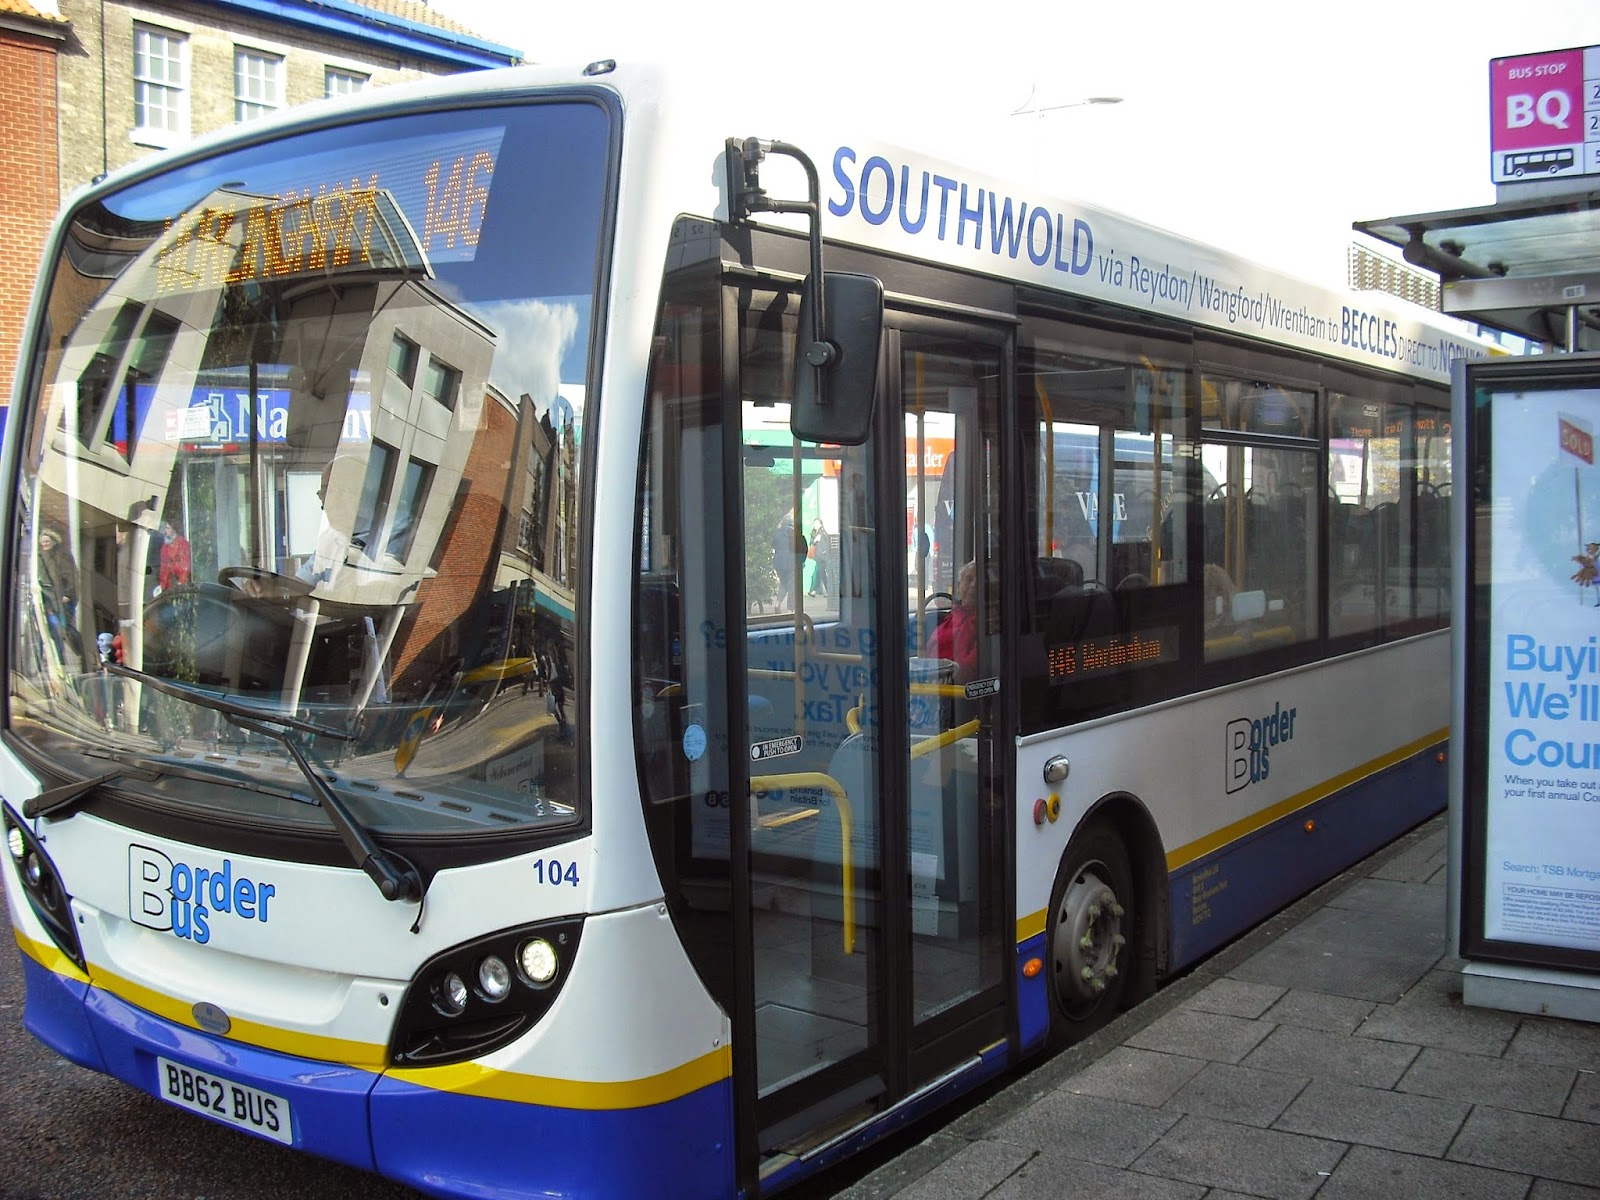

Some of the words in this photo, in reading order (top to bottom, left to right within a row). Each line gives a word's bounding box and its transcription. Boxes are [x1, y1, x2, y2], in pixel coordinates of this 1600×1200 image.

[1508, 67, 1533, 80] BUS
[1535, 63, 1567, 77] STOP
[1507, 90, 1571, 130] BQ
[422, 151, 494, 251] 146
[827, 145, 1095, 276] SOUTHWOLD
[1099, 249, 1124, 287] via
[1329, 318, 1339, 343] to
[1341, 305, 1398, 359] BECCLES
[1399, 336, 1427, 367] DIRECT
[1427, 345, 1438, 371] TO
[1562, 429, 1592, 457] SOLD
[1075, 491, 1128, 522] VAE
[1048, 645, 1077, 677] 146
[1507, 634, 1600, 681] Buyi
[1504, 681, 1599, 722] We'll
[762, 743, 769, 751] IN
[769, 738, 798, 750] EMERGENCY
[763, 748, 777, 758] PUSH
[777, 746, 784, 754] TO
[784, 744, 798, 753] OPEN
[1504, 775, 1534, 786] When
[1536, 777, 1554, 788] you
[1557, 778, 1577, 789] take
[1580, 780, 1597, 790] out
[1504, 789, 1525, 799] your
[1527, 788, 1546, 799] first
[1548, 791, 1580, 801] annual
[533, 859, 580, 887] 104
[1503, 861, 1540, 873] Search:
[1543, 864, 1564, 876] TSB
[128, 843, 276, 932] Border
[1507, 886, 1526, 894] YOUR
[1528, 888, 1548, 896] HOME
[1549, 890, 1564, 898] MAY
[166, 1064, 226, 1114] BB62
[231, 1086, 280, 1132] BUS
